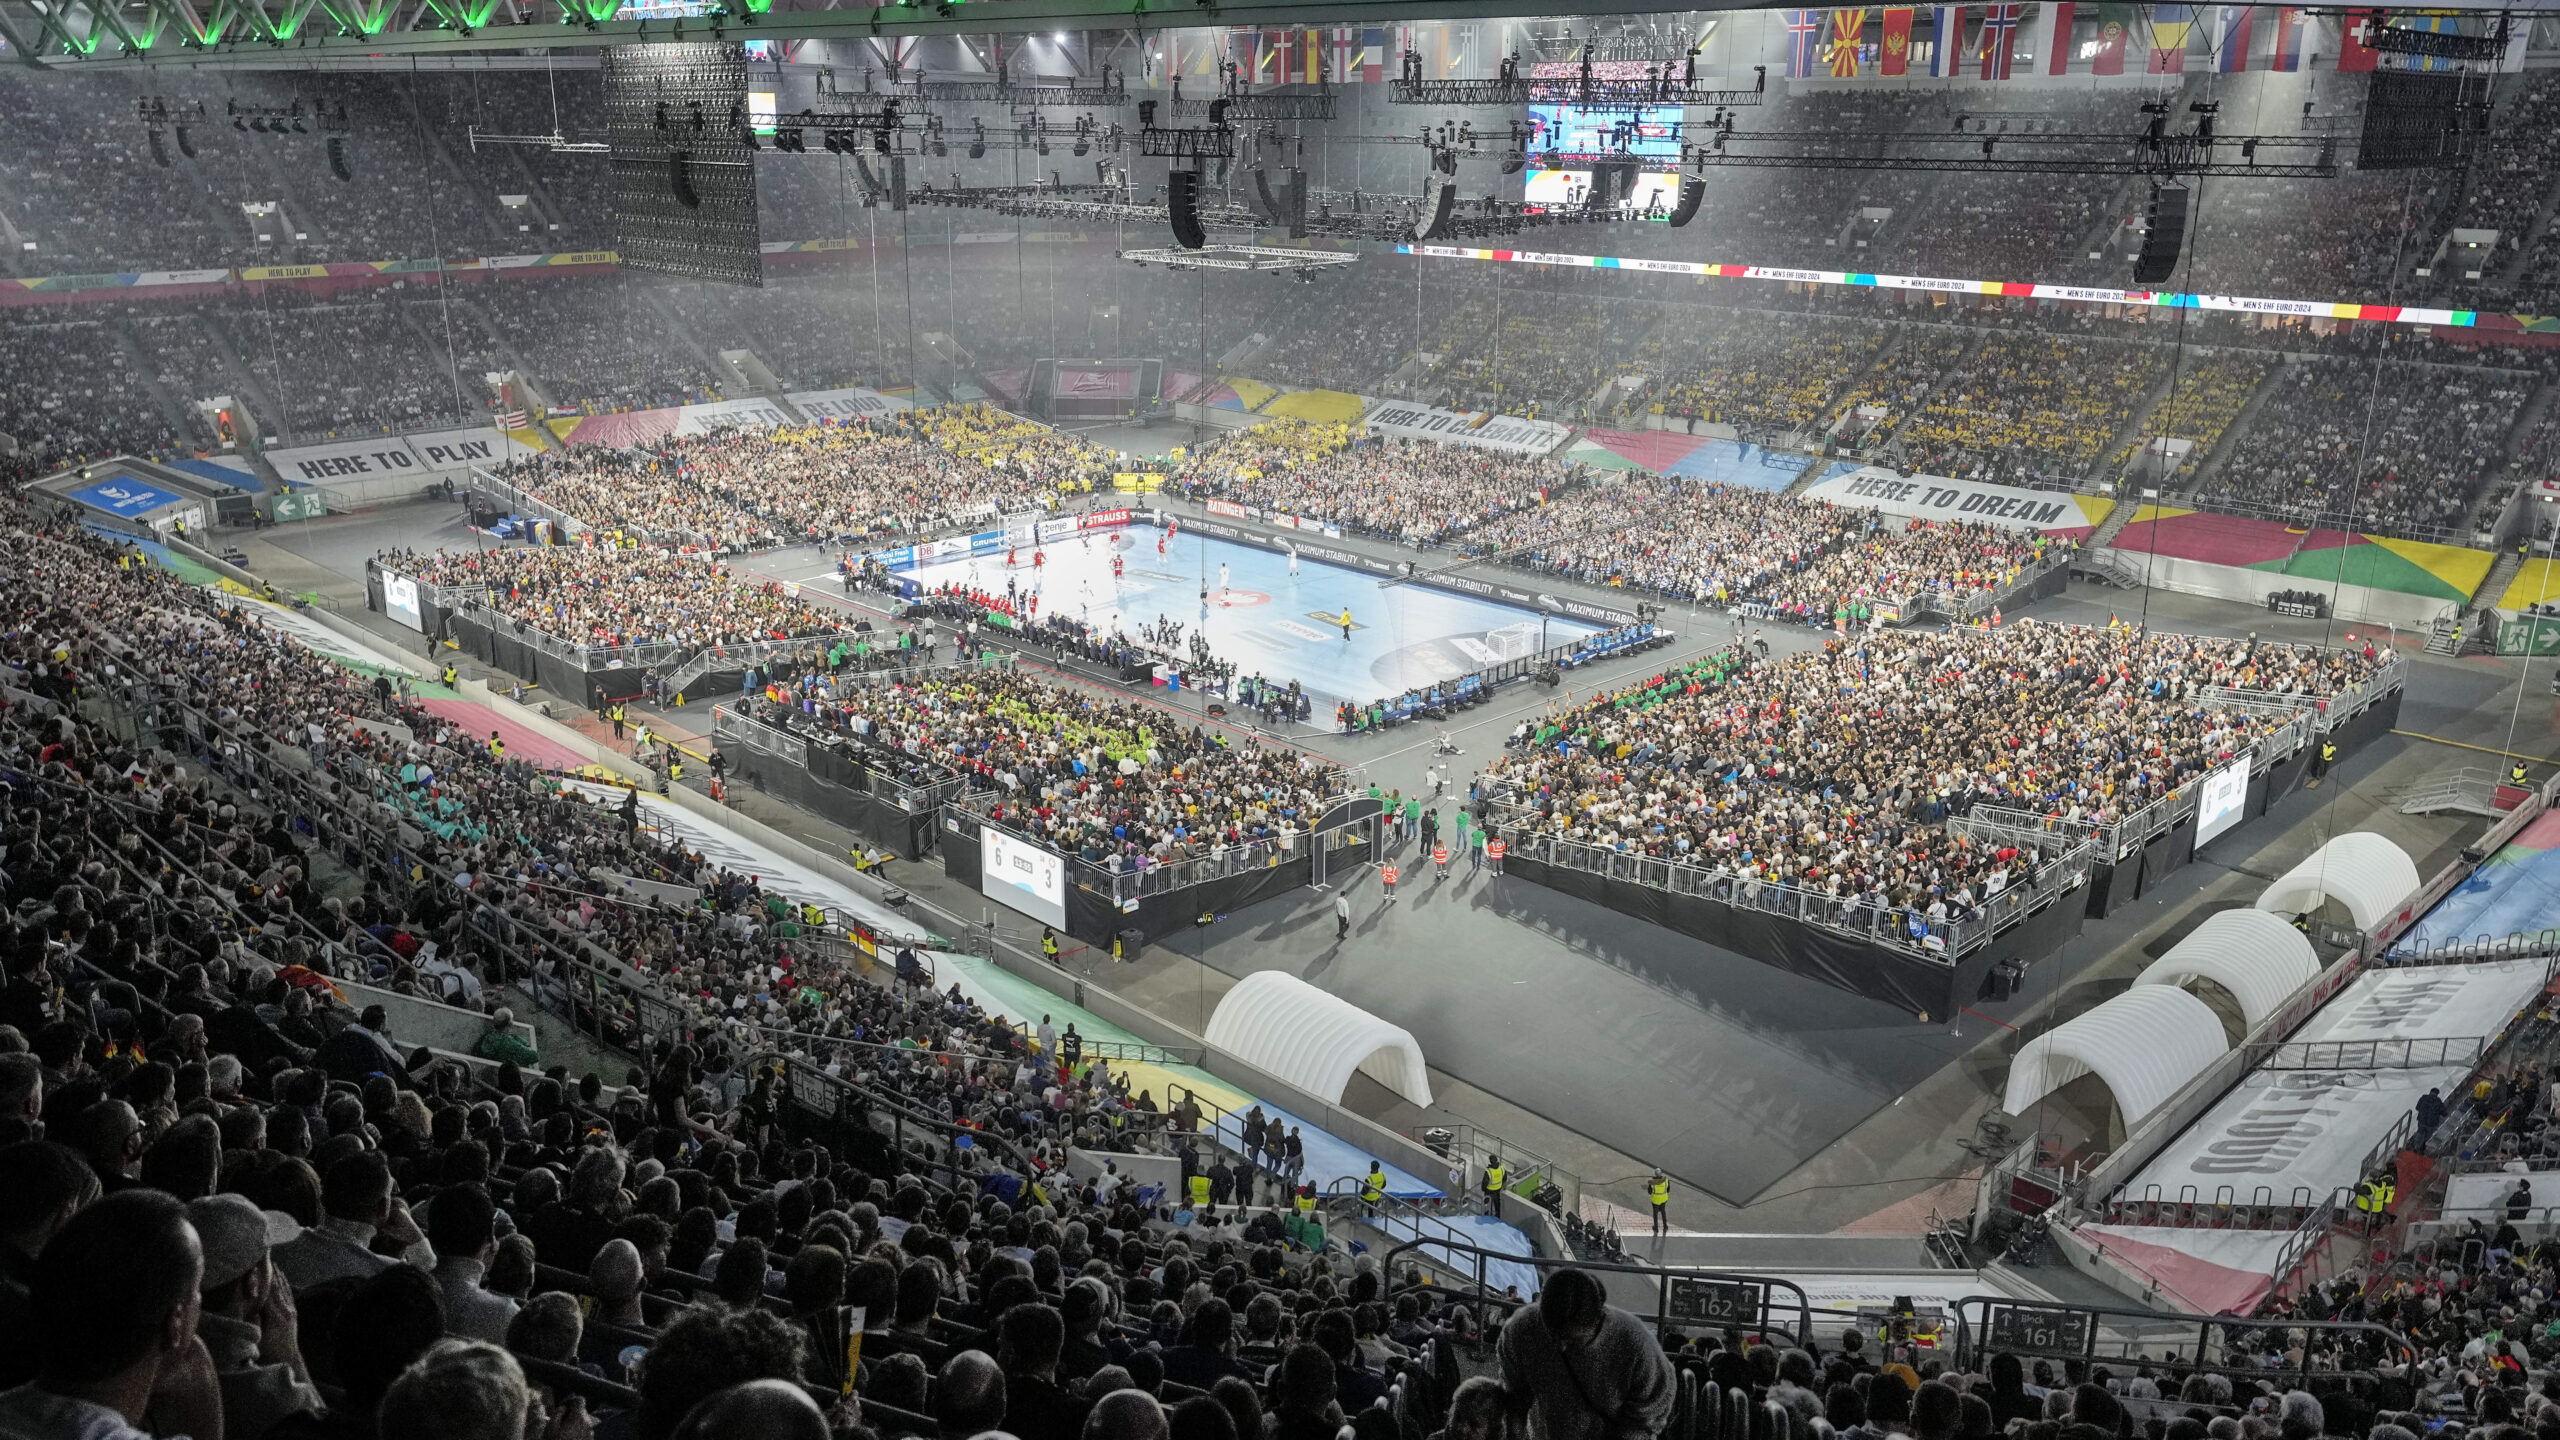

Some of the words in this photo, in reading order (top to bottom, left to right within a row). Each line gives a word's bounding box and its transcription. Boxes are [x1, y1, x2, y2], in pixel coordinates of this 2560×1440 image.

[571, 255, 584, 263] HERE
[585, 254, 592, 262] TO
[593, 253, 606, 261] PLAY
[268, 269, 284, 277] HERE
[286, 268, 293, 276] TO
[295, 267, 311, 276] PLAY
[1772, 270, 1786, 279] MEN'S
[1786, 271, 1795, 280] EHF
[1796, 272, 1807, 281] EURO
[1808, 273, 1820, 282] 2024
[1911, 279, 1926, 288] MEN'S
[1927, 280, 1936, 289] EHF
[1937, 281, 1950, 290] EURO
[1951, 282, 1965, 291] 2024
[2067, 289, 2083, 298] MEN'S
[2085, 291, 2094, 299] EHF
[2096, 291, 2111, 300] EURO
[2112, 292, 2125, 301] 202
[2243, 301, 2262, 310] MEN'S
[2263, 302, 2275, 311] EHF
[2276, 302, 2293, 312] EURO
[2294, 303, 2312, 313] 2024
[755, 408, 784, 423] TO
[801, 402, 829, 418] BE
[835, 395, 887, 413] LOUD
[1373, 408, 1425, 429] HERE
[1424, 414, 1449, 432] TO
[297, 455, 373, 480] HERE
[371, 451, 413, 470] TO
[425, 440, 493, 464] PLAY
[1845, 477, 1920, 502] HERE
[1919, 486, 1960, 508] TO
[1958, 492, 2066, 524] DREAM
[1207, 501, 1246, 518] RATINGEN
[1088, 511, 1128, 526] STRAUSS
[1182, 518, 1209, 531] MAXIMUM
[1209, 524, 1238, 538] STABILITY
[920, 546, 932, 556] DB
[1295, 542, 1325, 557] MAXIMUM
[1326, 550, 1358, 564] STABILITY
[1457, 578, 1493, 595] STABILITY
[1507, 590, 1530, 602] hummel
[1565, 602, 1605, 619] MAXIMUM
[995, 847, 1002, 867] 6
[1111, 858, 1119, 866] 10
[1045, 869, 1052, 889] 3
[806, 1087, 823, 1106] 163
[2190, 1107, 2341, 1175] LOUD
[1696, 1285, 1719, 1295] Block
[1700, 1298, 1734, 1317] 162
[2021, 1314, 2045, 1325] Block
[2024, 1327, 2057, 1346] 161
